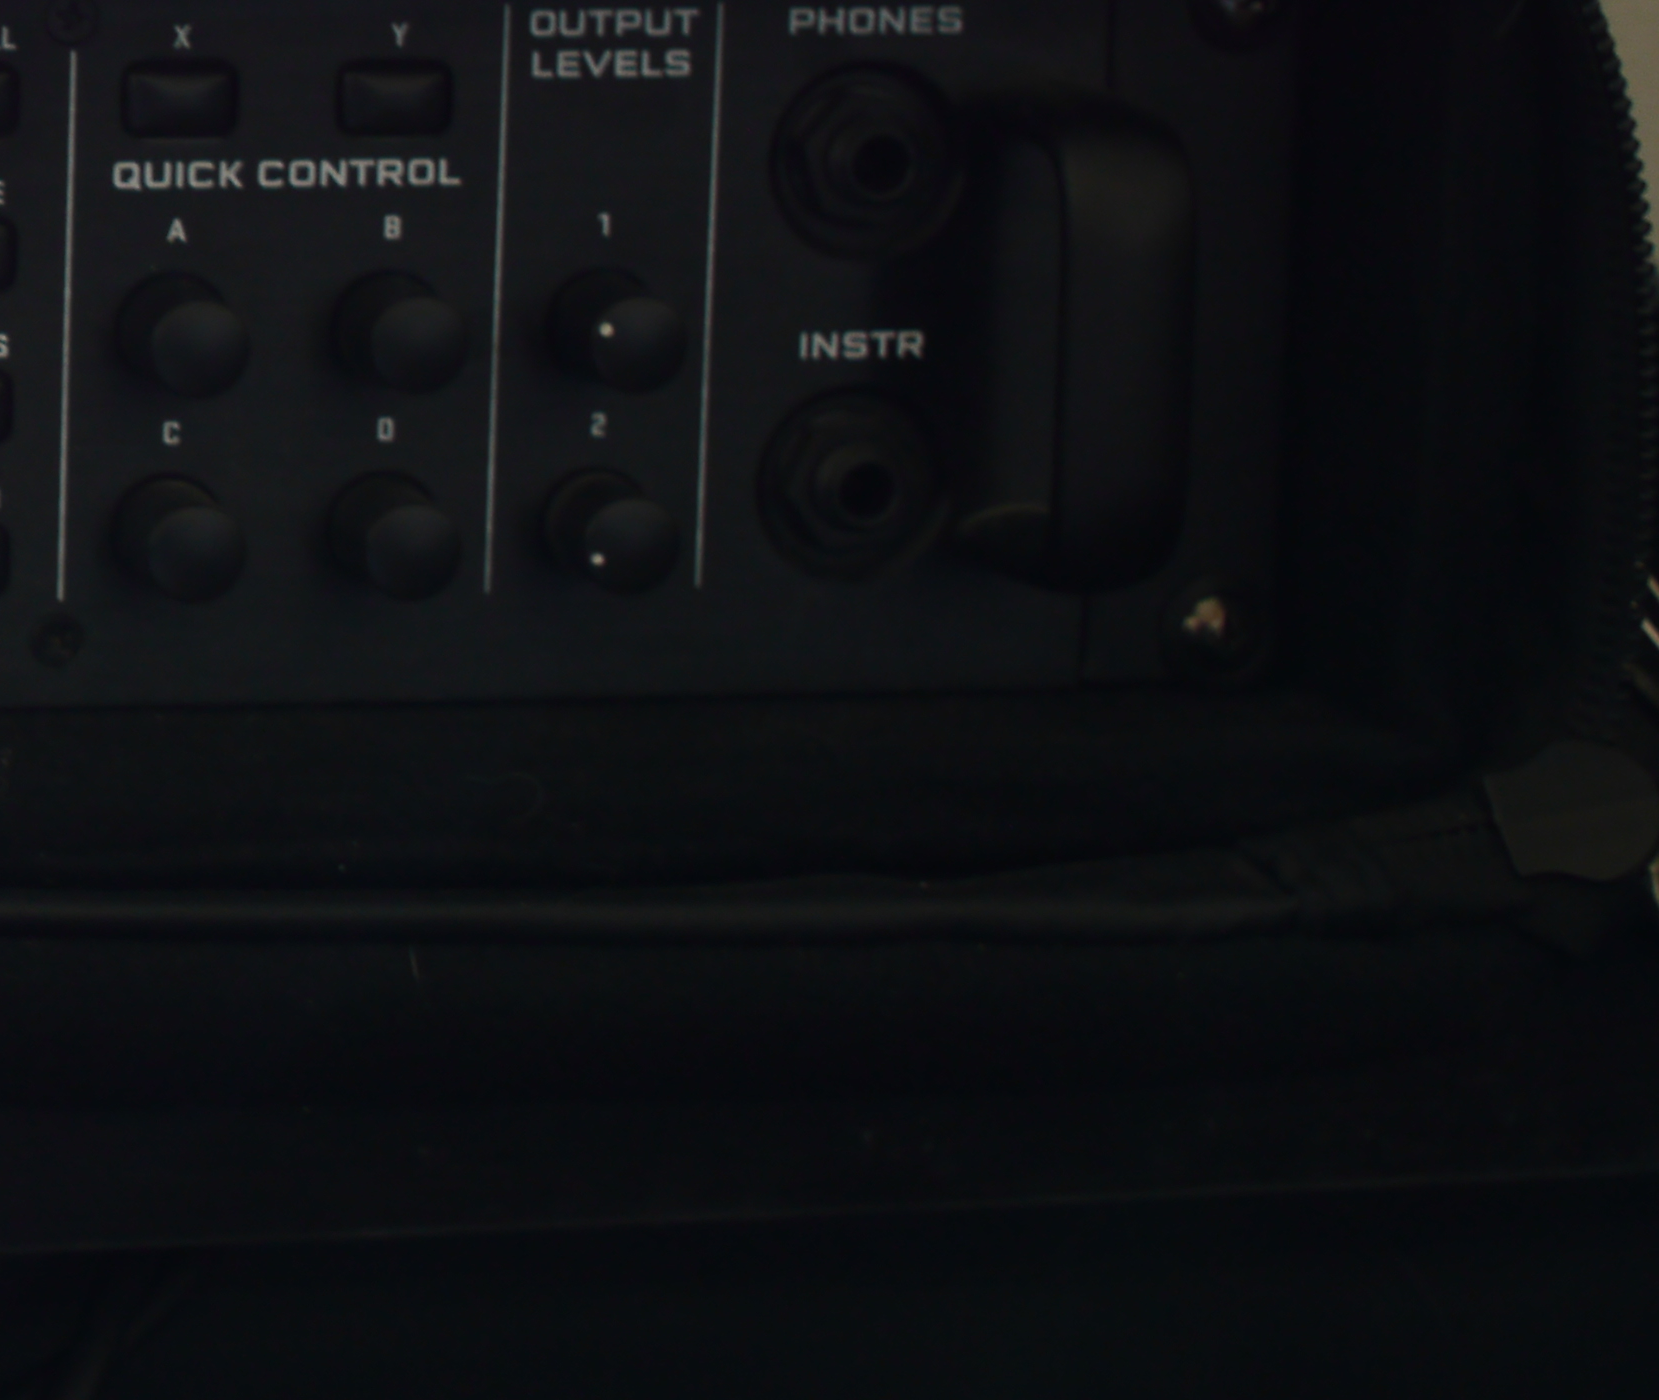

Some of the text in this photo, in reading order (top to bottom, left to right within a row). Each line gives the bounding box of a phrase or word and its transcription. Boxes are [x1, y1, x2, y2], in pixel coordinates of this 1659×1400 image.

[529, 8, 699, 38] OUTPUT
[789, 7, 963, 34] PHONES
[174, 25, 191, 48] X
[391, 23, 408, 47] Y
[531, 49, 691, 78] LEVELS
[112, 158, 461, 190] QUICK CONTROL
[167, 218, 187, 242] A
[383, 214, 402, 240] B
[598, 212, 611, 236] 1
[799, 331, 924, 359] INSTR
[162, 420, 181, 445] C
[376, 417, 395, 442] D
[590, 412, 607, 437] 2
